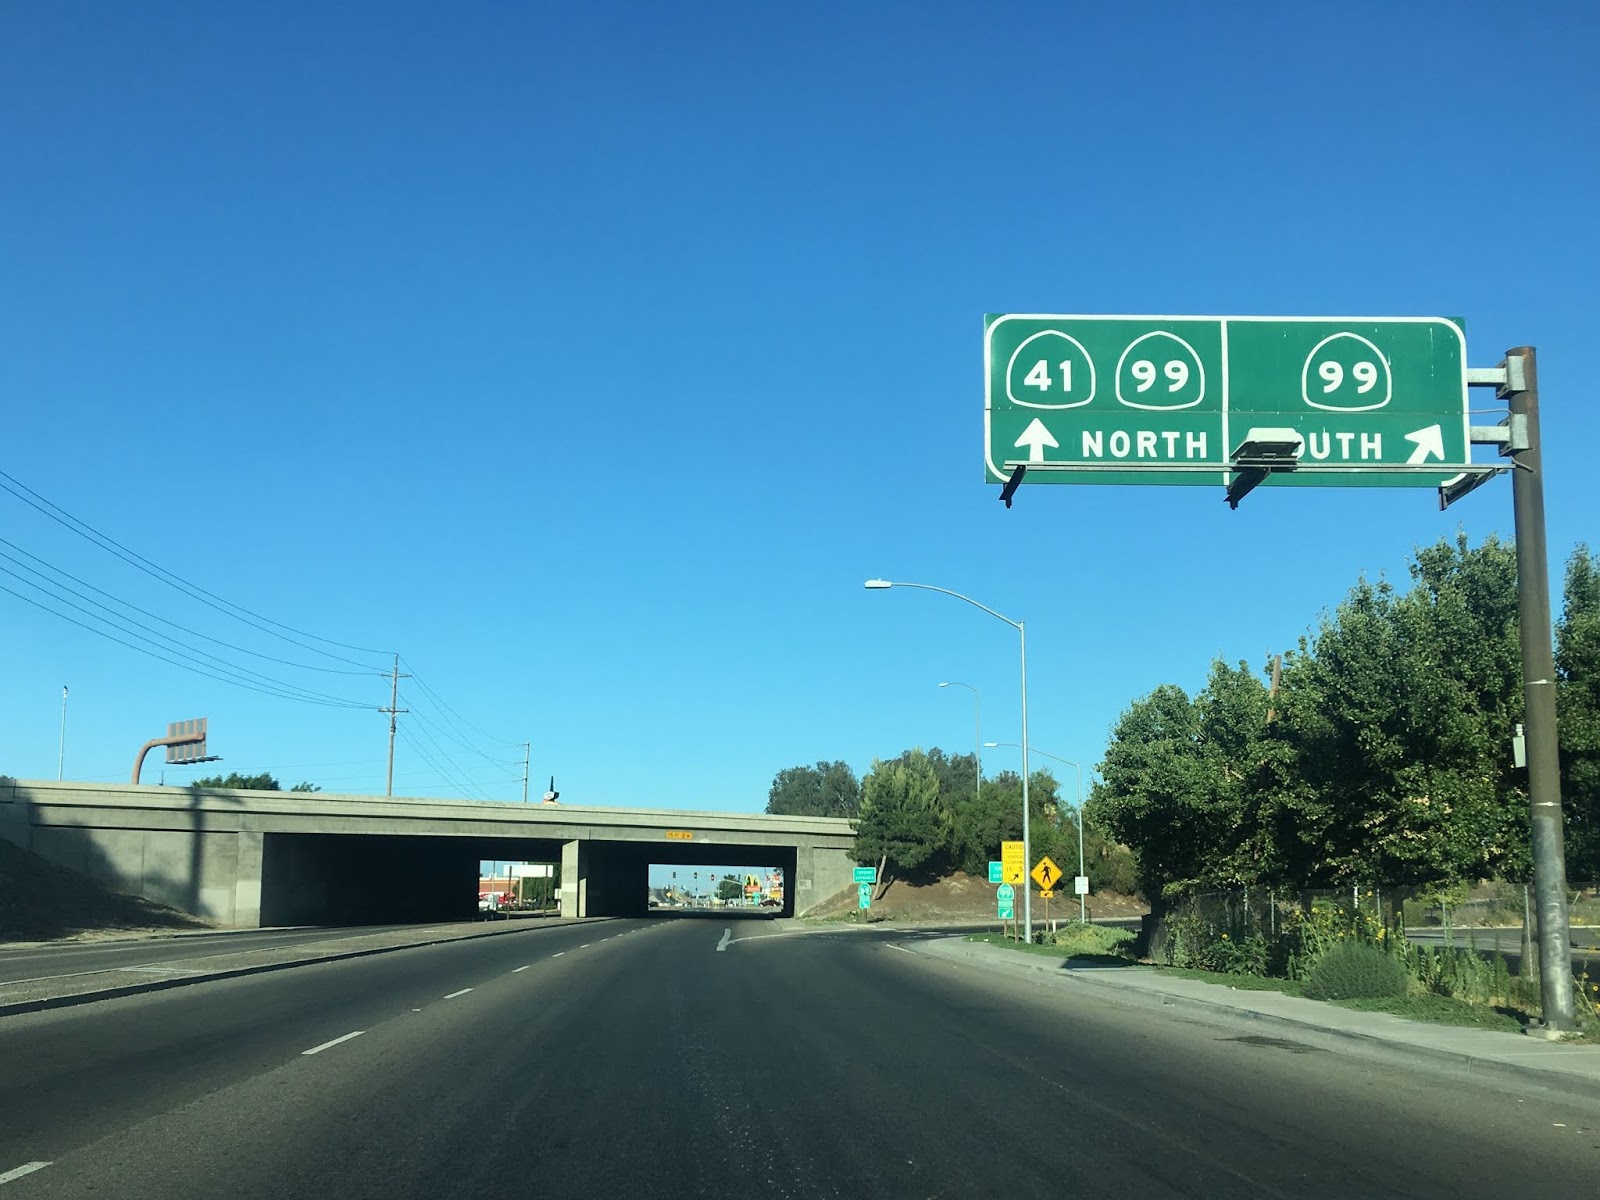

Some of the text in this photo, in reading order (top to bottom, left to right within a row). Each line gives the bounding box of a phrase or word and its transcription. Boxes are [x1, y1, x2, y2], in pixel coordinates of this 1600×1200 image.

[1024, 359, 1072, 392] 41
[1131, 360, 1189, 393] 99
[1318, 361, 1378, 394] 99
[1082, 430, 1207, 459] NORTH
[1295, 431, 1382, 460] UTH
[1000, 889, 1011, 897] 99
